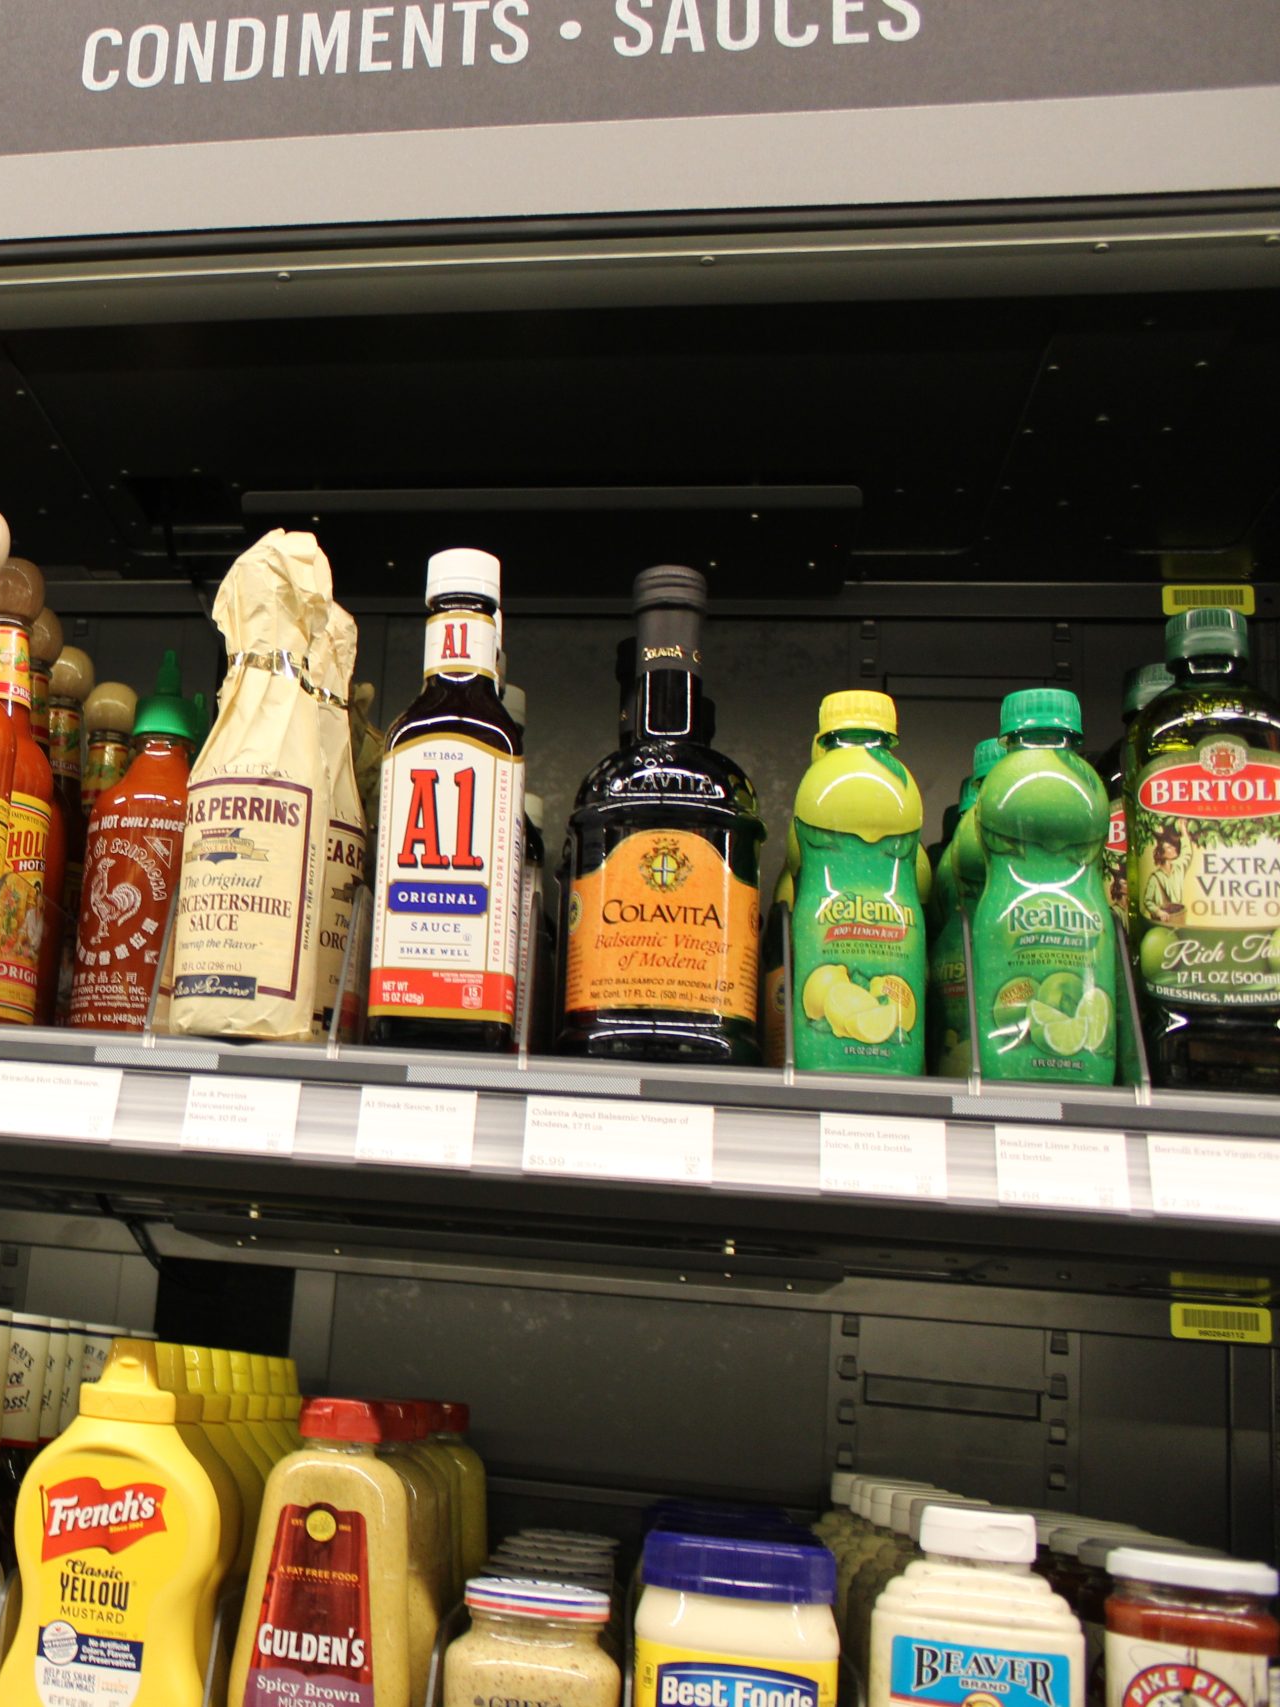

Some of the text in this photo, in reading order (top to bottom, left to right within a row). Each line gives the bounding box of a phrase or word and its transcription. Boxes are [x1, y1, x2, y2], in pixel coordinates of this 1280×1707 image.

[81, 0, 923, 92] CONDIMENTS SAUCES
[439, 752, 464, 761] 1862
[195, 796, 300, 827] & PERRINS
[101, 814, 119, 830] HOT
[121, 816, 149, 829] CHILI
[150, 818, 185, 833] SAUCE
[110, 838, 167, 902] SRIRACHA
[496, 858, 505, 889] PORK
[202, 873, 263, 891] Original
[180, 892, 293, 918] RCESTERSHIRE
[398, 890, 477, 905] ORIGINAL
[1191, 900, 1258, 917] OLIVE
[820, 896, 915, 926] ReaLemon
[1009, 902, 1103, 934] ReaLime
[189, 913, 239, 932] SAUCE
[410, 921, 463, 934] SAUCE
[222, 938, 258, 951] Flavor
[400, 947, 470, 957] SHAKE WELL
[492, 941, 501, 962] FOR
[594, 932, 733, 957] Balsamic Vinegar
[1160, 939, 1225, 969] Rich
[618, 951, 707, 973] of Modena
[382, 981, 408, 992] NET WT
[615, 978, 735, 993] BALSAMICO IGP
[1177, 971, 1229, 984] 17 FL OZ
[1156, 985, 1221, 1003] DRESSINGS,
[528, 1154, 565, 1167] $5.99
[48, 1488, 155, 1537] French's
[65, 1558, 124, 1582] Classic
[287, 1566, 359, 1582] FAT FREE FOOD
[60, 1571, 130, 1613] YELLOW
[60, 1604, 125, 1626] MUSTARD
[258, 1623, 366, 1669] GULDEN'S
[913, 1645, 1054, 1706] BEAVER
[960, 1678, 1010, 1694] BRAND
[256, 1675, 361, 1704] Spicy Brown
[662, 1676, 814, 1707] Best Foods
[1131, 1669, 1240, 1707] PIKE PIE
